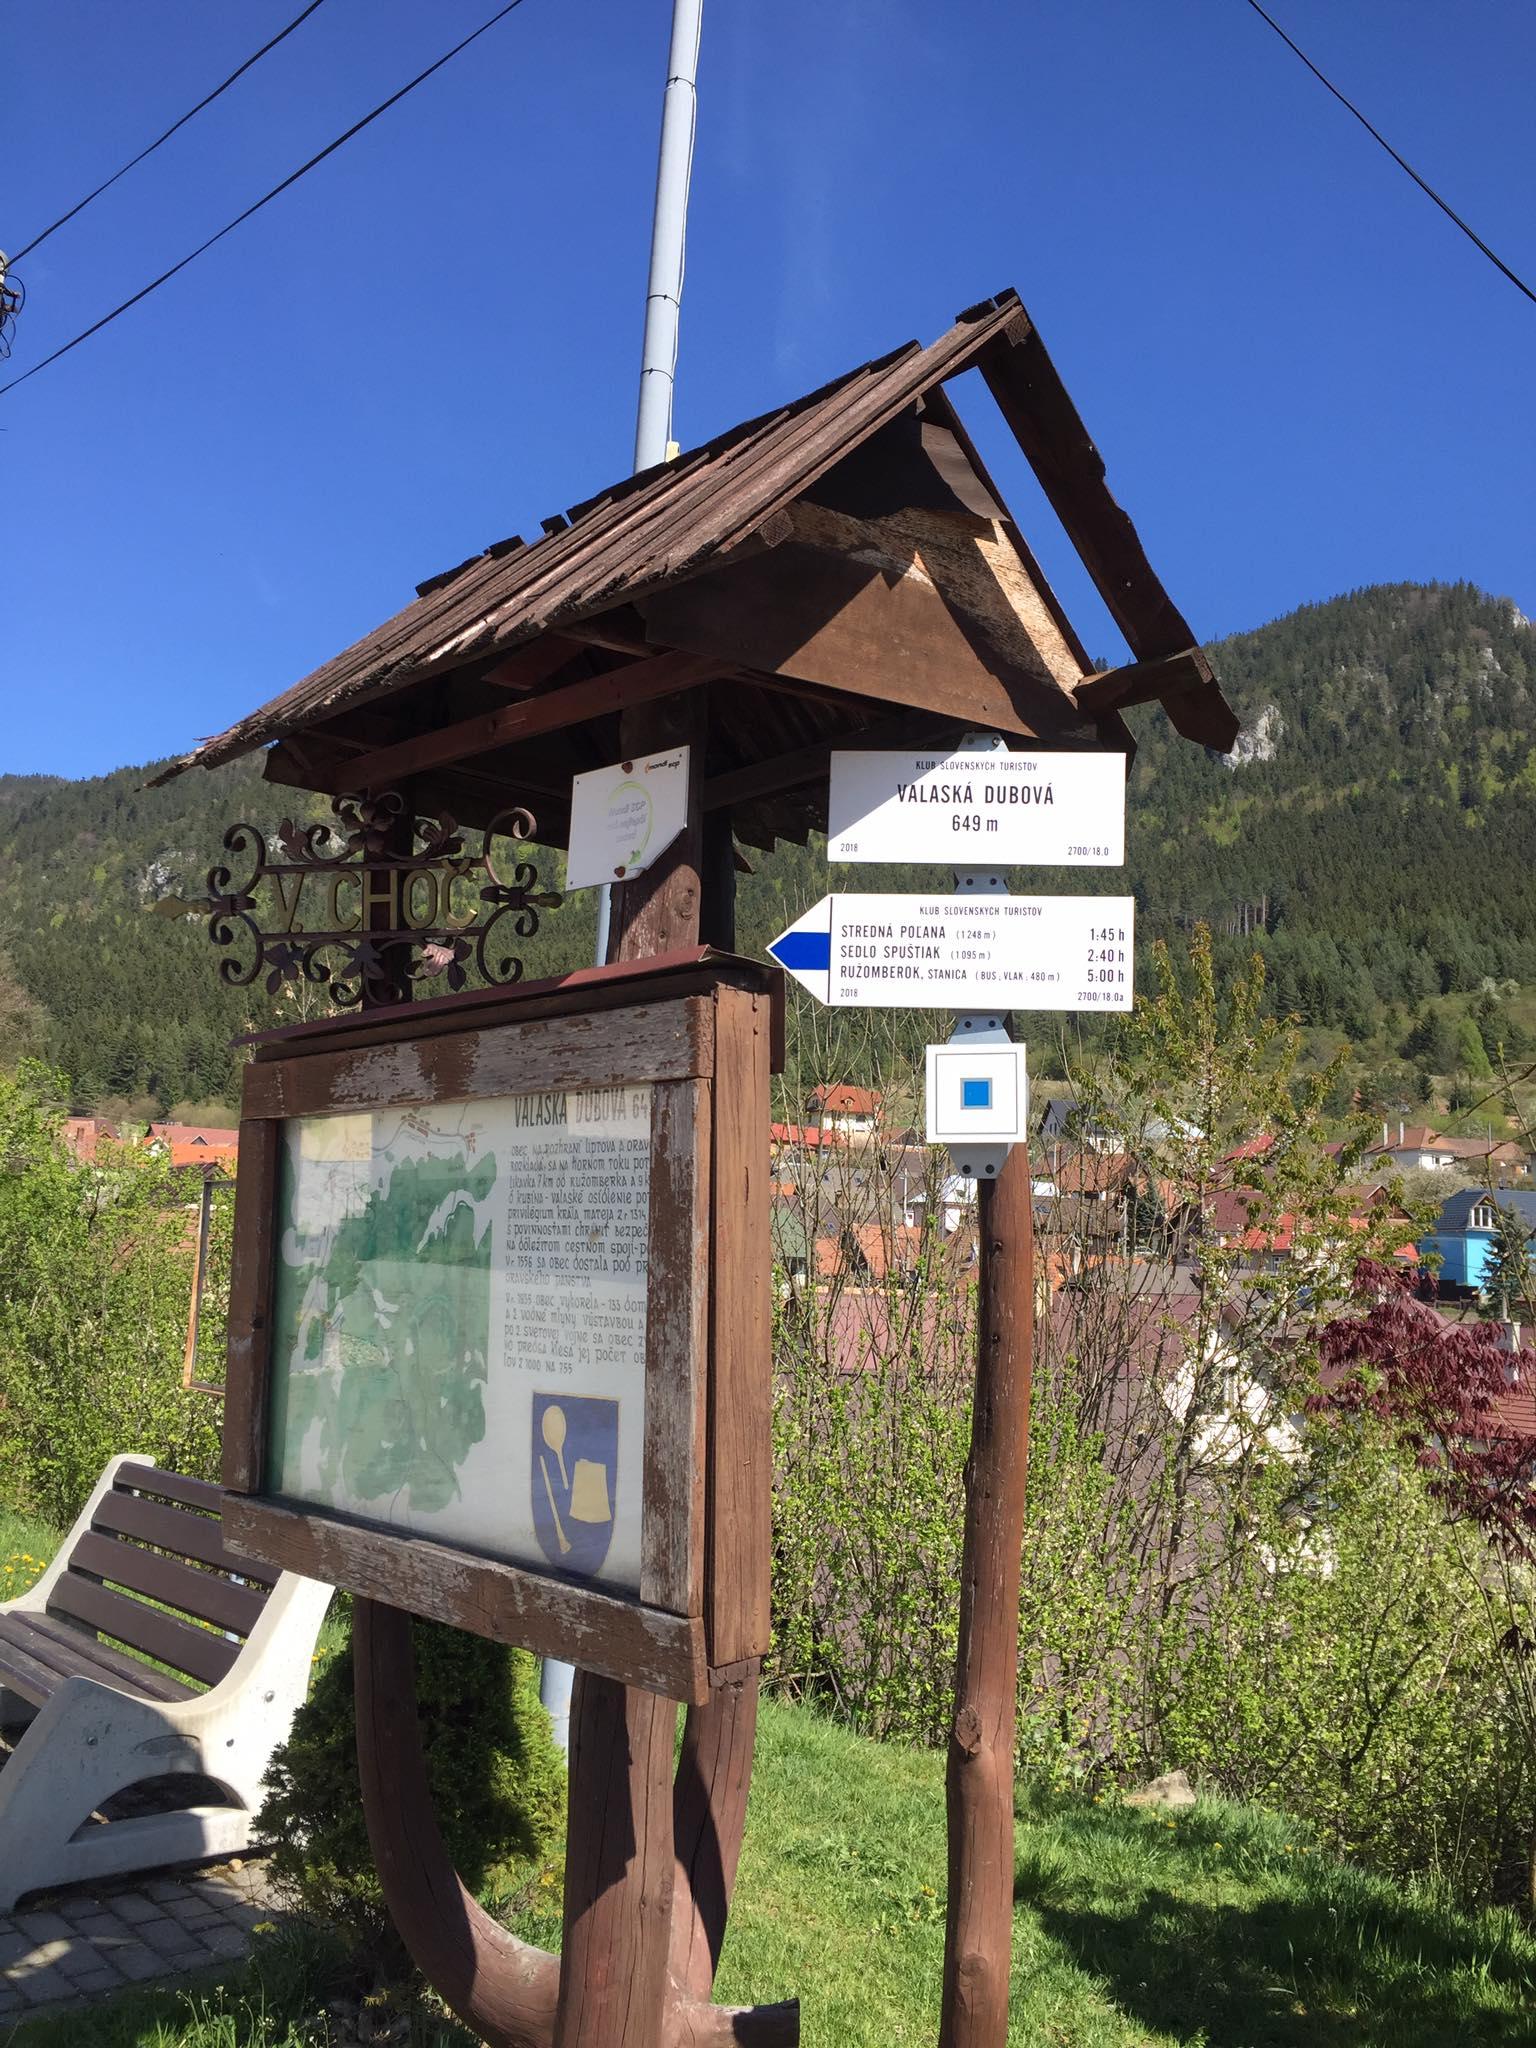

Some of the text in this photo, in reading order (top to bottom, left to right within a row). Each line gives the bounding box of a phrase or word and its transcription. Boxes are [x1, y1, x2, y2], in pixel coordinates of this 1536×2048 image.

[915, 760, 936, 770] KLUB
[1000, 762, 1038, 771] TURISTOV
[897, 781, 1054, 805] VALASKÁ DUBOVÁ
[952, 814, 998, 832] 649 m
[840, 842, 858, 852] 2018
[327, 858, 479, 932] CHOČ
[919, 906, 940, 915] KLUB
[1004, 907, 1042, 916] TURISTOV
[841, 923, 893, 938] STREDNÁ
[1090, 928, 1116, 941] 1:45
[1118, 928, 1125, 941] h
[840, 945, 876, 958] SEDLO
[883, 943, 941, 959] SPUŠTIAK
[1087, 949, 1115, 962] 2:40
[1118, 949, 1125, 962] h
[840, 963, 924, 980] RUŽOMBEROK,
[927, 969, 967, 980] STANICA
[1030, 972, 1046, 981] 480
[1087, 969, 1115, 982] 5:00
[1117, 969, 1125, 982] h
[840, 988, 858, 998] 2018
